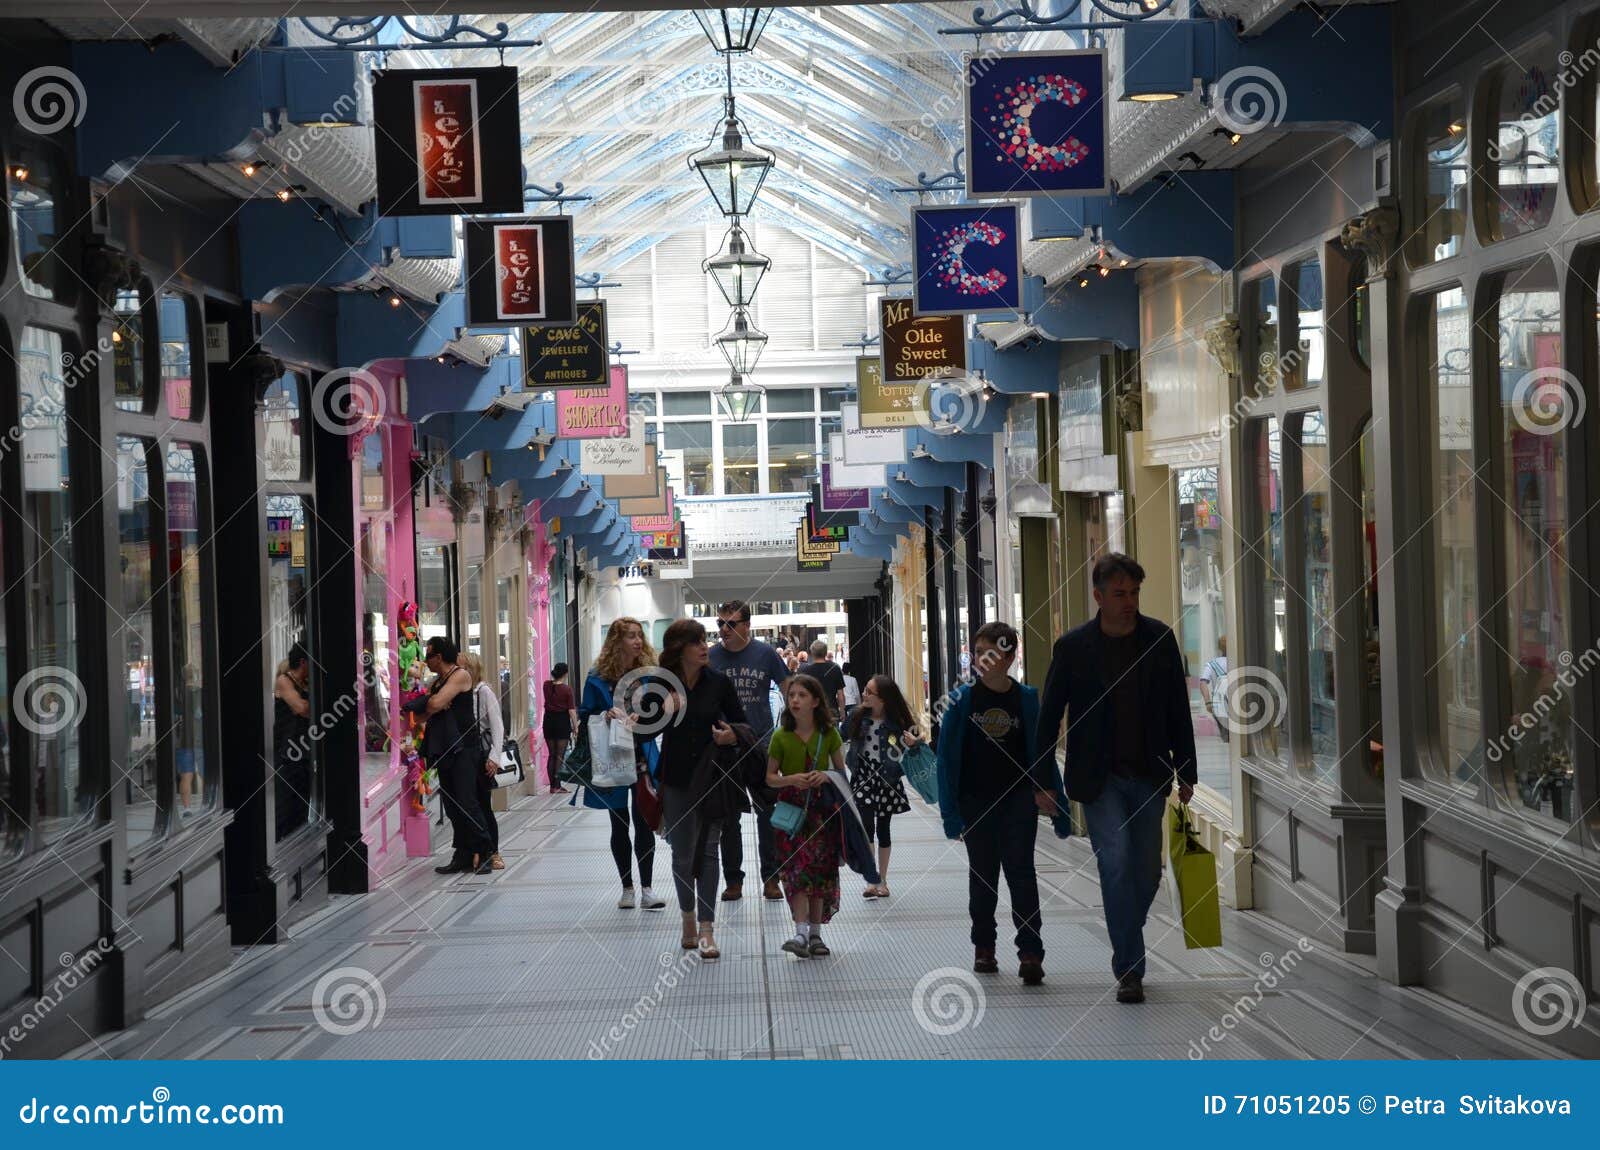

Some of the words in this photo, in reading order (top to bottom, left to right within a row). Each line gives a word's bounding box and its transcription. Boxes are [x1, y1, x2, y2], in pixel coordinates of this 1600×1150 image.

[886, 302, 910, 328] Mr
[547, 328, 582, 341] CAVE
[905, 328, 943, 344] Olde
[539, 345, 589, 356] JEWELLERY
[901, 346, 948, 360] Sweet
[544, 369, 588, 380] ANTIQUES
[895, 362, 952, 379] Shoppe
[618, 564, 654, 578] OFFICE
[740, 667, 765, 680] MAR
